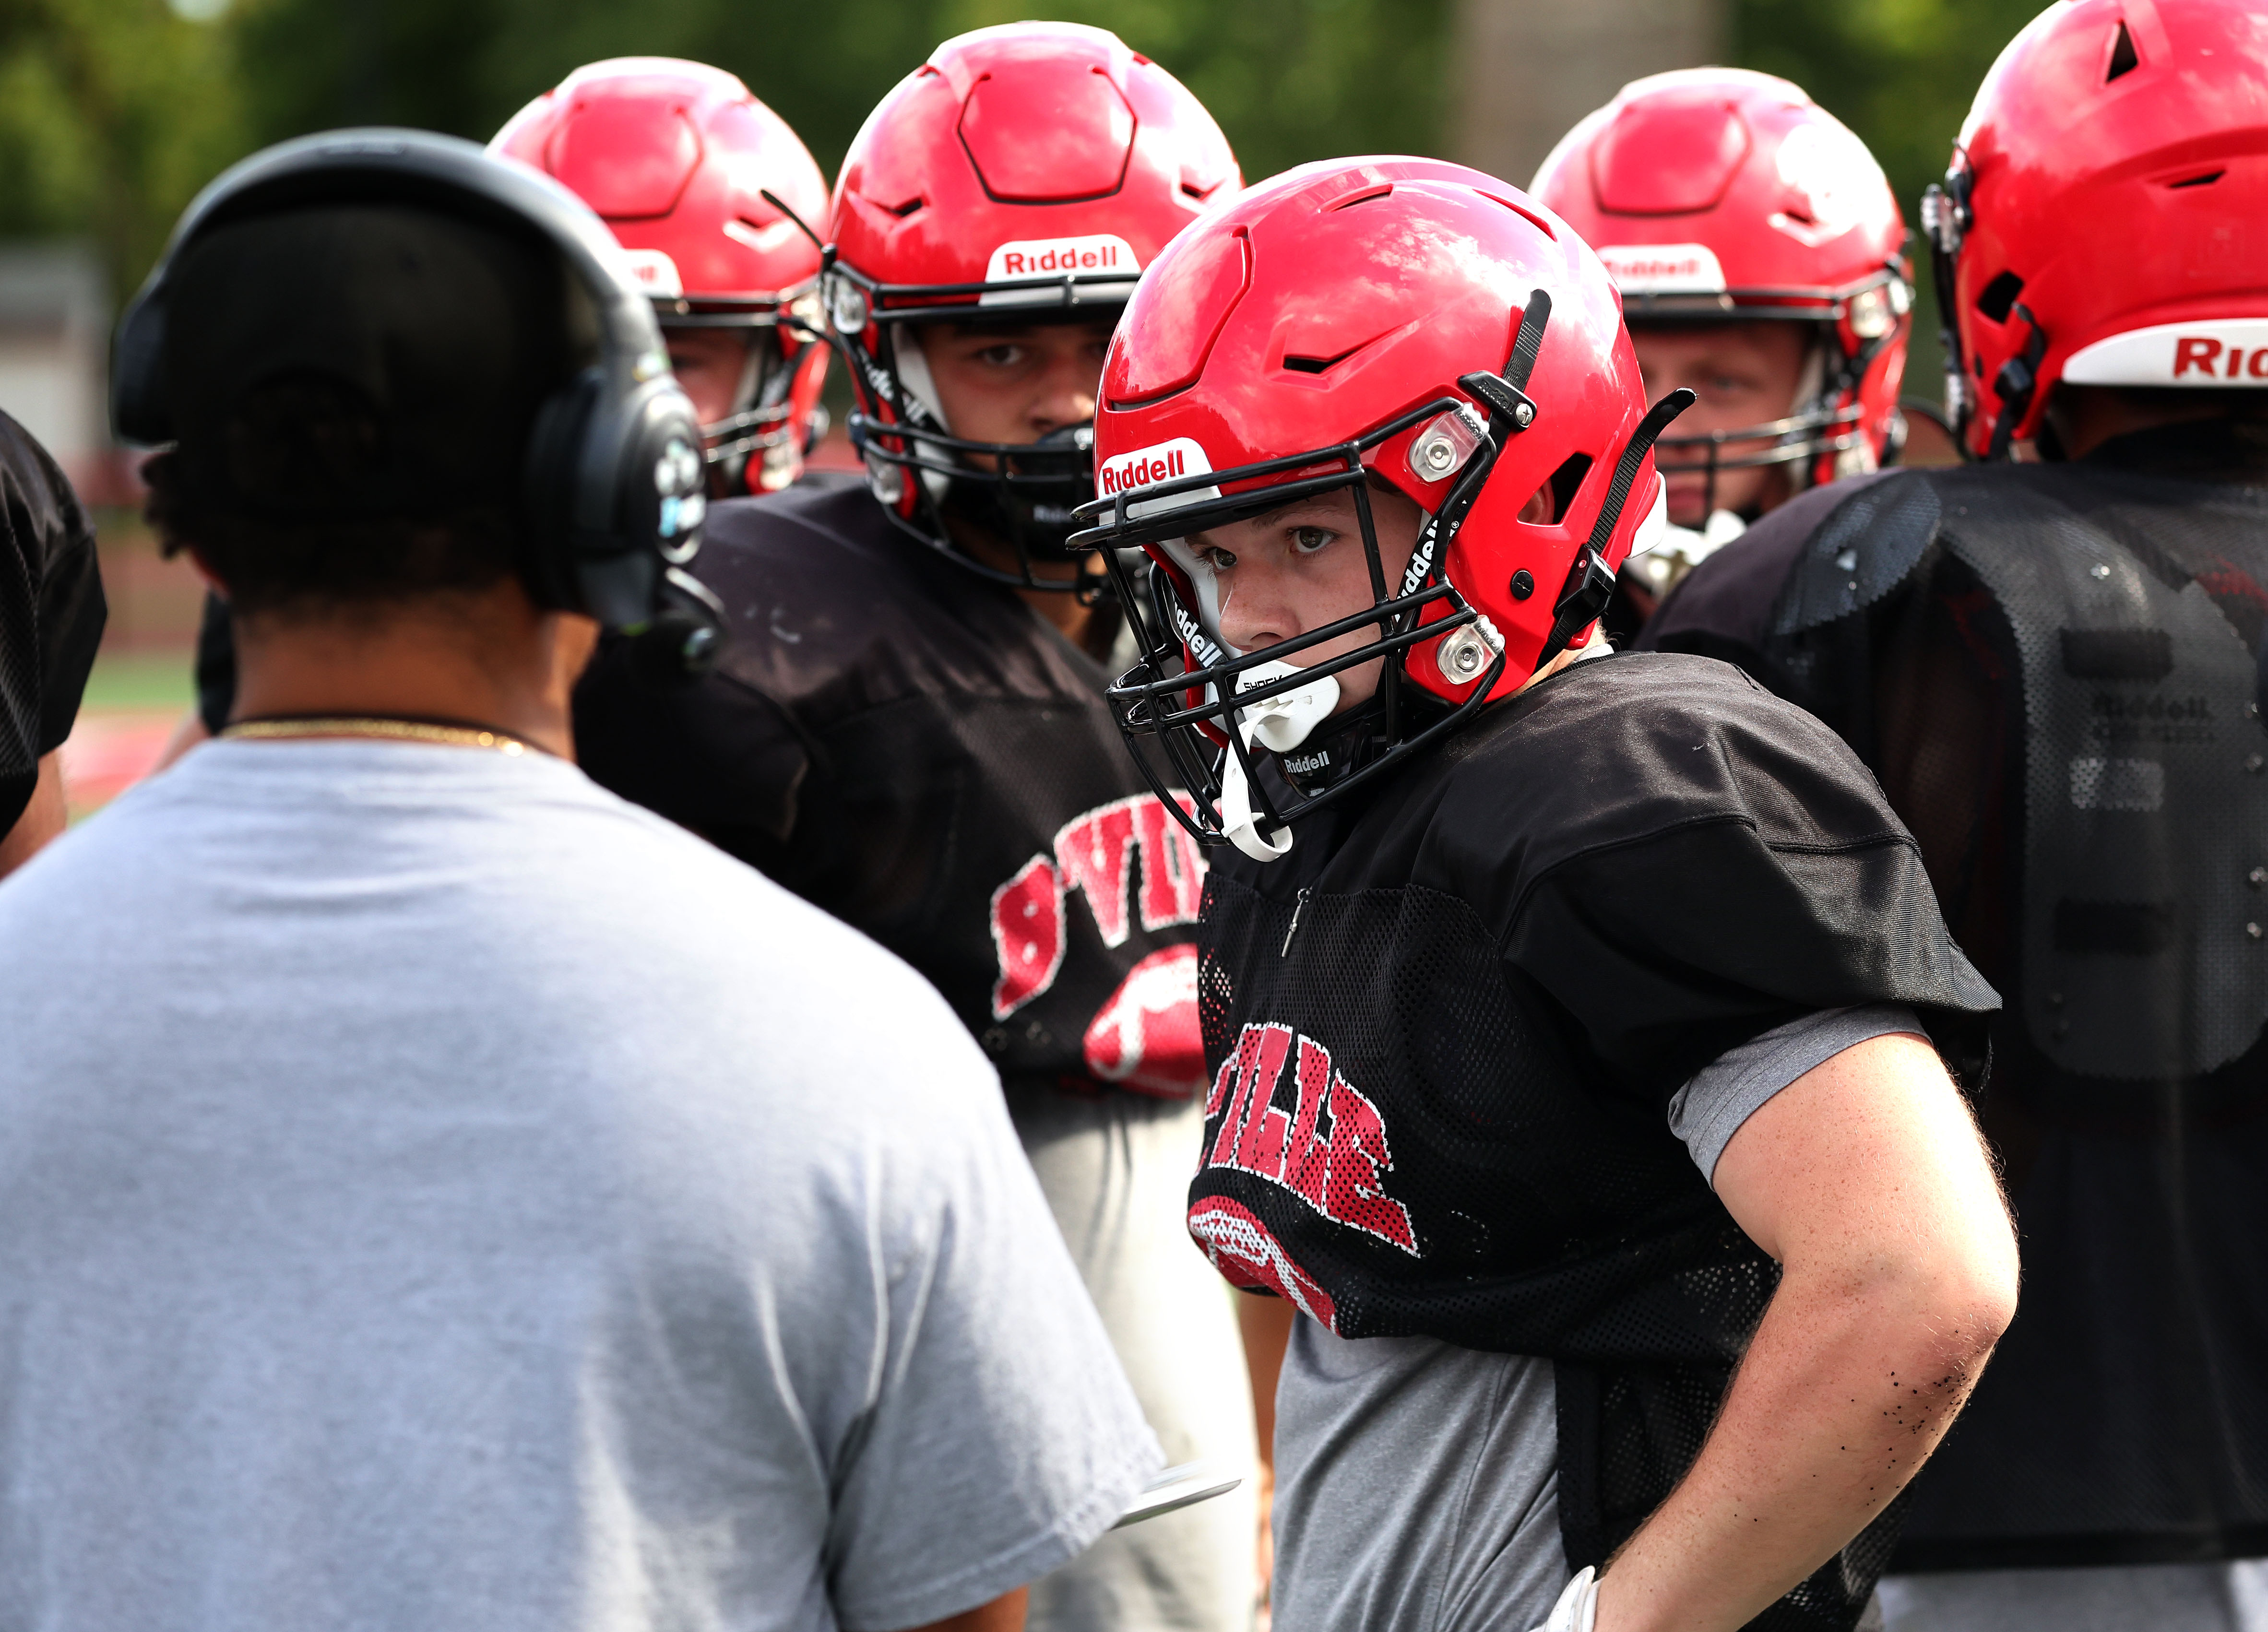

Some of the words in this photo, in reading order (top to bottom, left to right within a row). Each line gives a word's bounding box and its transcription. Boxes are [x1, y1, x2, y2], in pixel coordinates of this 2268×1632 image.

[1004, 245, 1117, 275] Riddell
[1102, 449, 1185, 495] Riddell
[1283, 750, 1330, 773] Riddell
